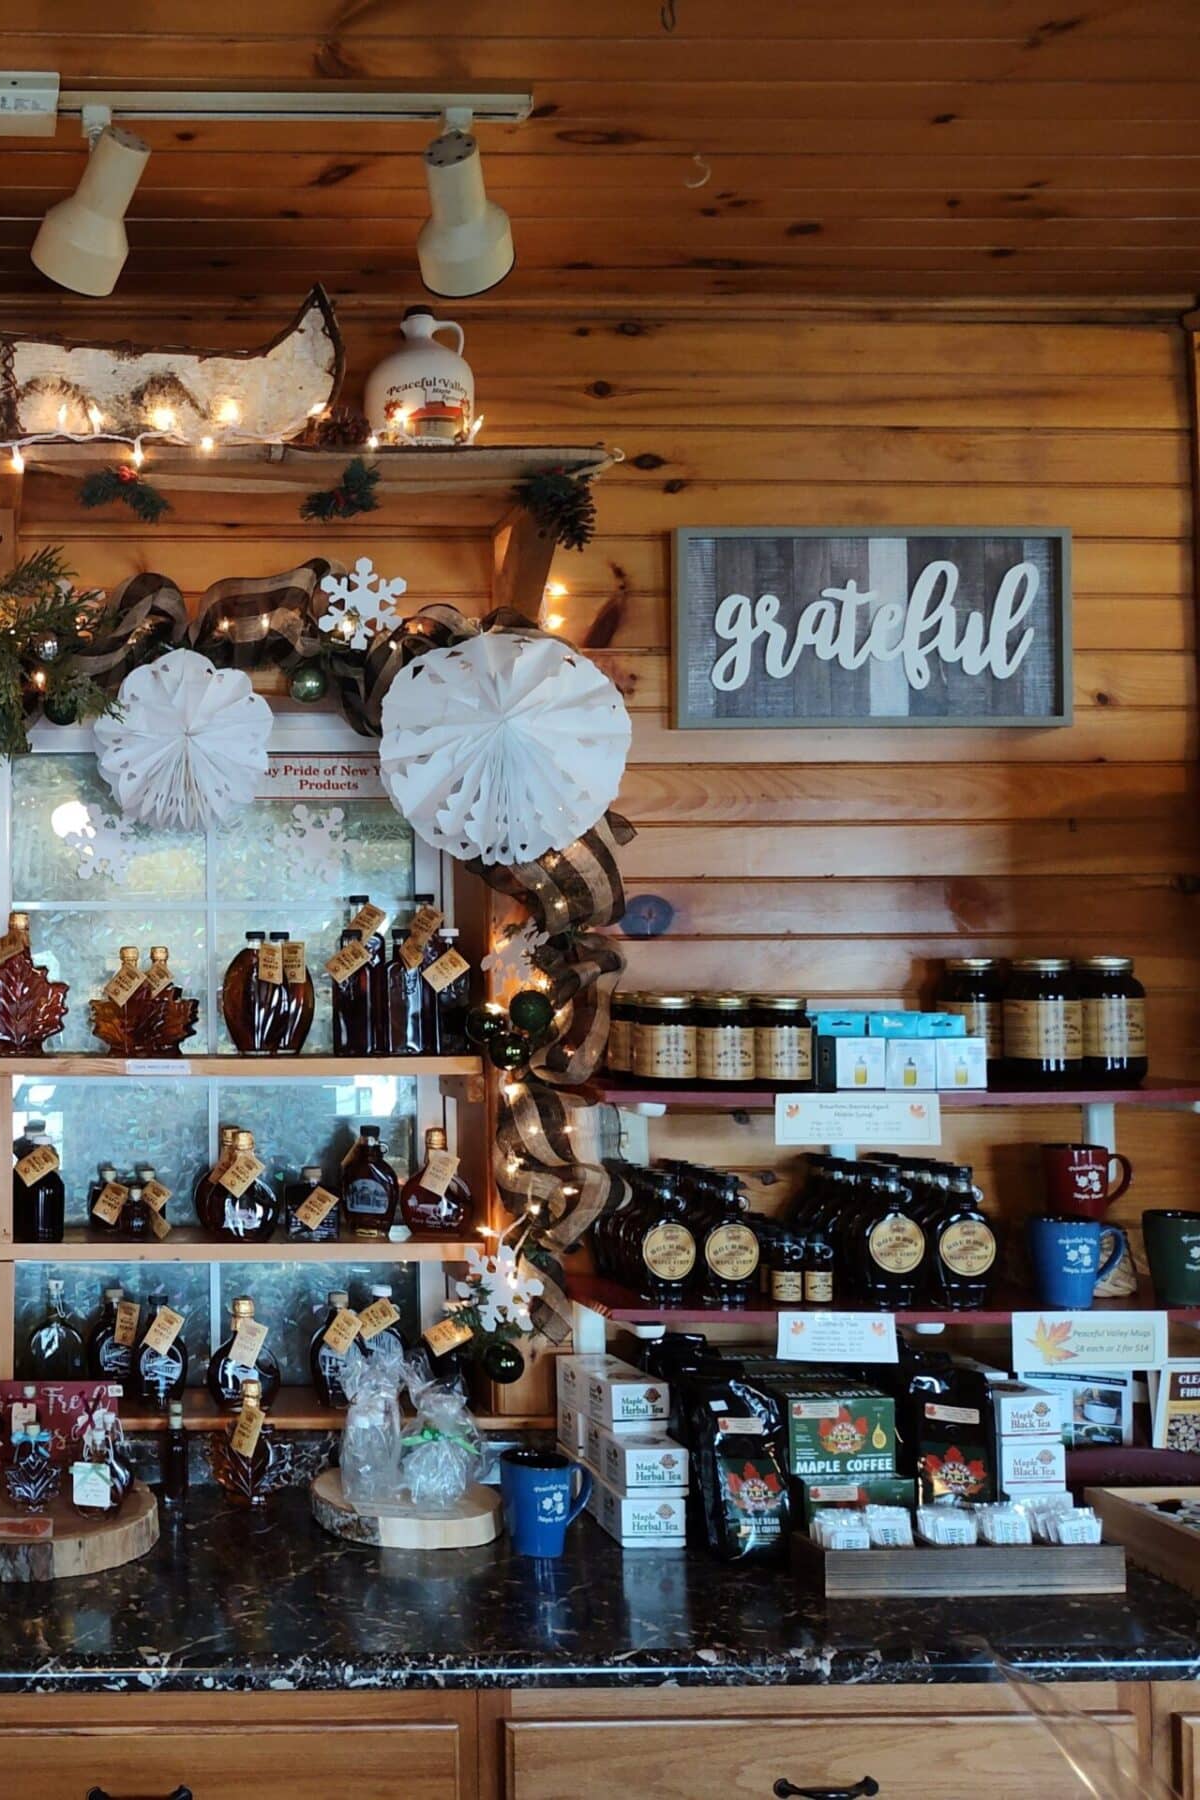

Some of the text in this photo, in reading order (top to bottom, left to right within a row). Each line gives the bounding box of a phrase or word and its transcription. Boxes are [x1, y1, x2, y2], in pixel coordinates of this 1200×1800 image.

[386, 376, 468, 398] Peaceful Valley
[711, 560, 1040, 691] grateful
[283, 765, 320, 777] Pride
[323, 765, 337, 777] of
[340, 766, 369, 777] New
[299, 779, 359, 791] Products
[1072, 1329, 1151, 1338] Peaceful Valley Mugs
[1086, 1344, 1104, 1352] each
[785, 1390, 833, 1398] MAPLE
[621, 1397, 643, 1408] Maple
[621, 1405, 664, 1416] Herbal Tea
[1011, 1411, 1034, 1420] Maple
[1011, 1419, 1050, 1429] Black Tea
[635, 1463, 659, 1474] Maple
[796, 1458, 893, 1474] MAPLE COFFEE
[1013, 1458, 1038, 1468] Maple
[635, 1471, 682, 1482] Herbal Tea
[1013, 1466, 1056, 1476] Black Tea
[937, 1472, 977, 1484] MAPLE
[632, 1512, 656, 1523] Maple
[632, 1520, 679, 1531] Herbal Tea
